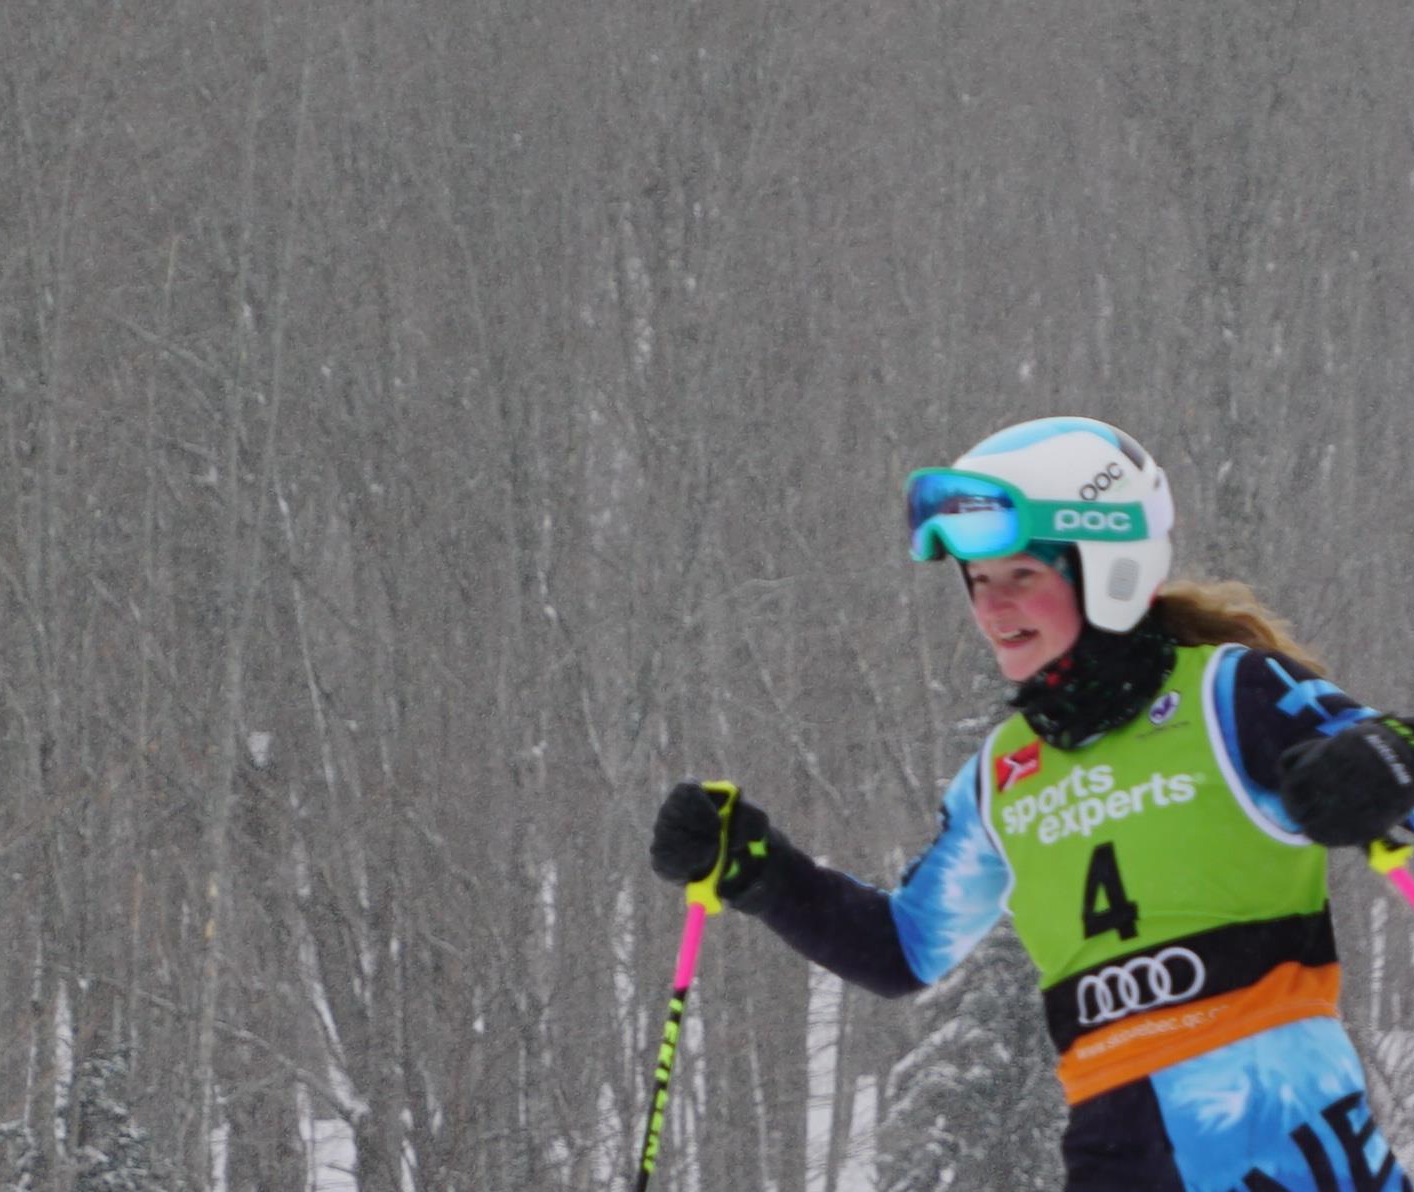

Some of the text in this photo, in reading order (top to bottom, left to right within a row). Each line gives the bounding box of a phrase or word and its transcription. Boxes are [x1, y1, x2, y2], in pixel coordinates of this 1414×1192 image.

[1002, 764, 1114, 834] sports
[1039, 772, 1196, 844] experts
[1082, 841, 1139, 941] 4
